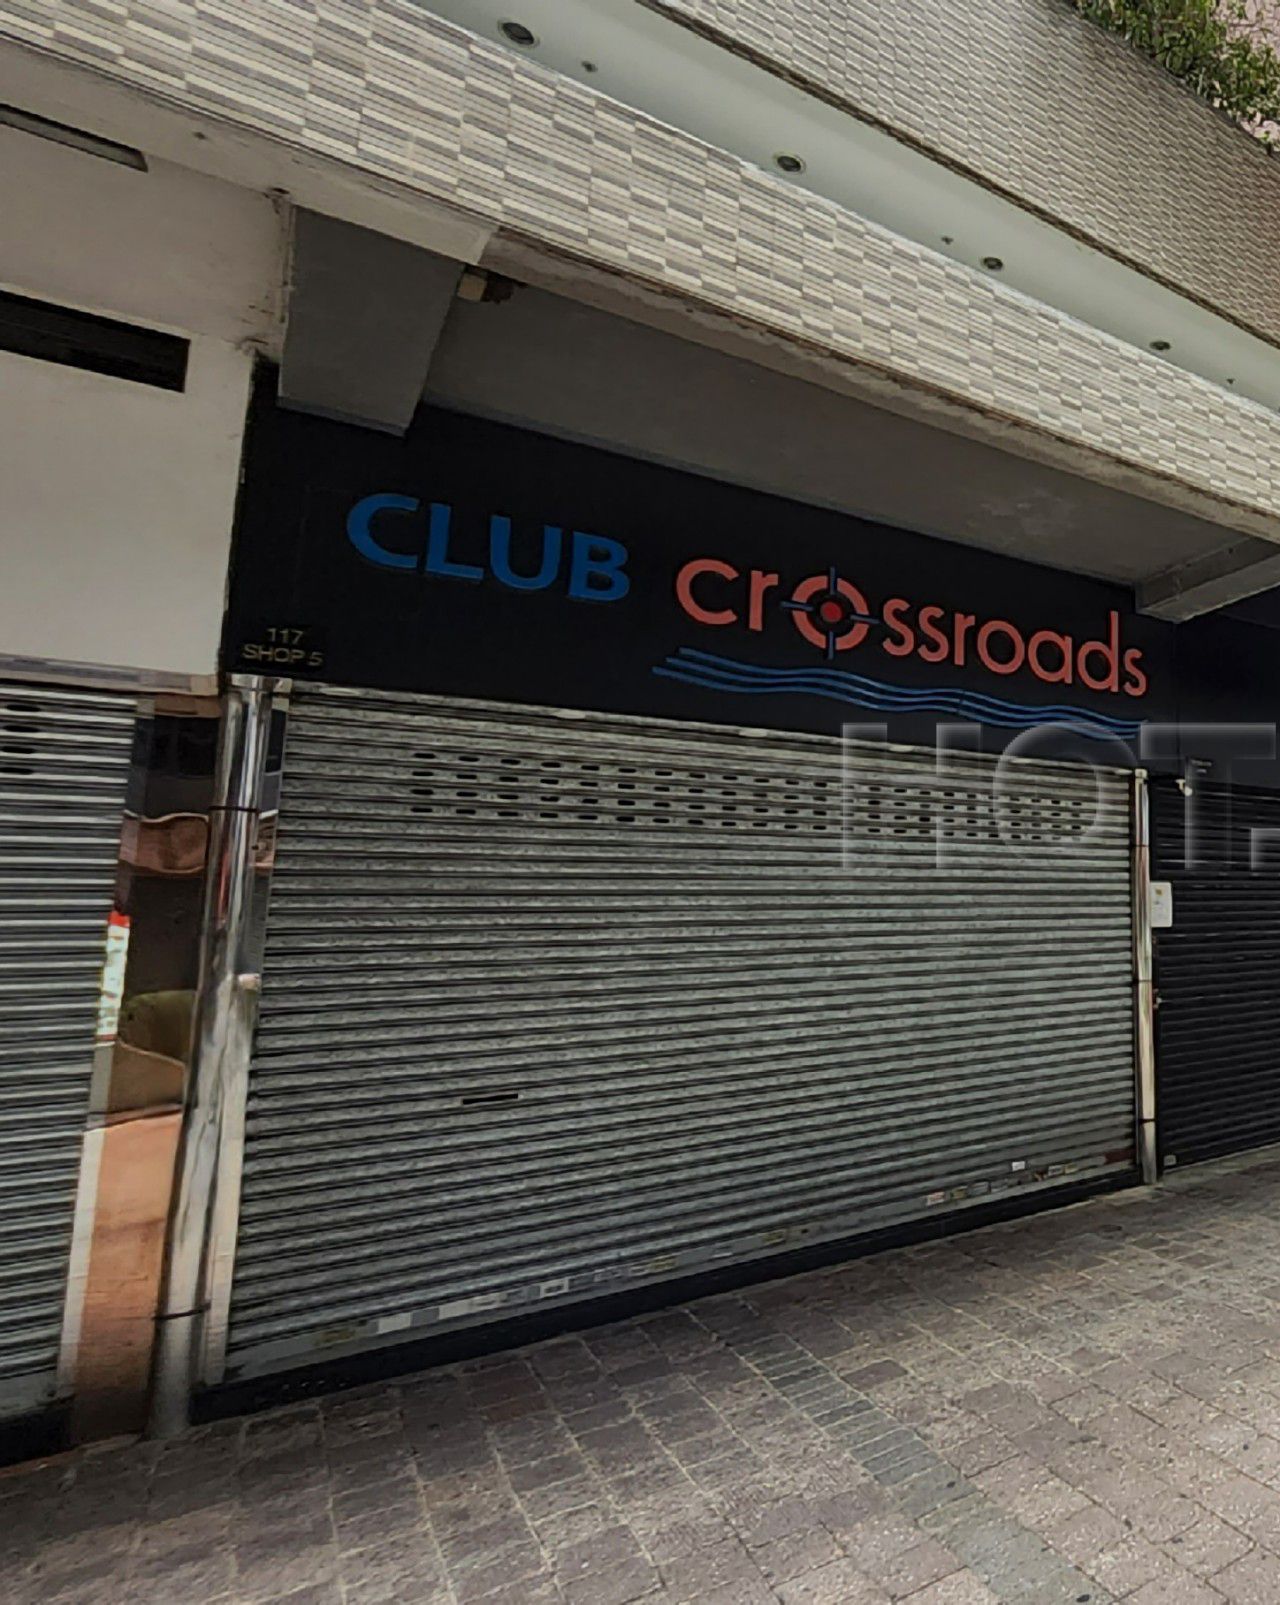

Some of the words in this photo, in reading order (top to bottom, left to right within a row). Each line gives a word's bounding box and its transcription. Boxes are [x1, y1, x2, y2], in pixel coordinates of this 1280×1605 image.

[346, 492, 631, 604] CLUB
[242, 643, 305, 665] SHOP
[307, 651, 323, 667] 5
[267, 628, 304, 645] 117
[675, 558, 1149, 698] crossroads
